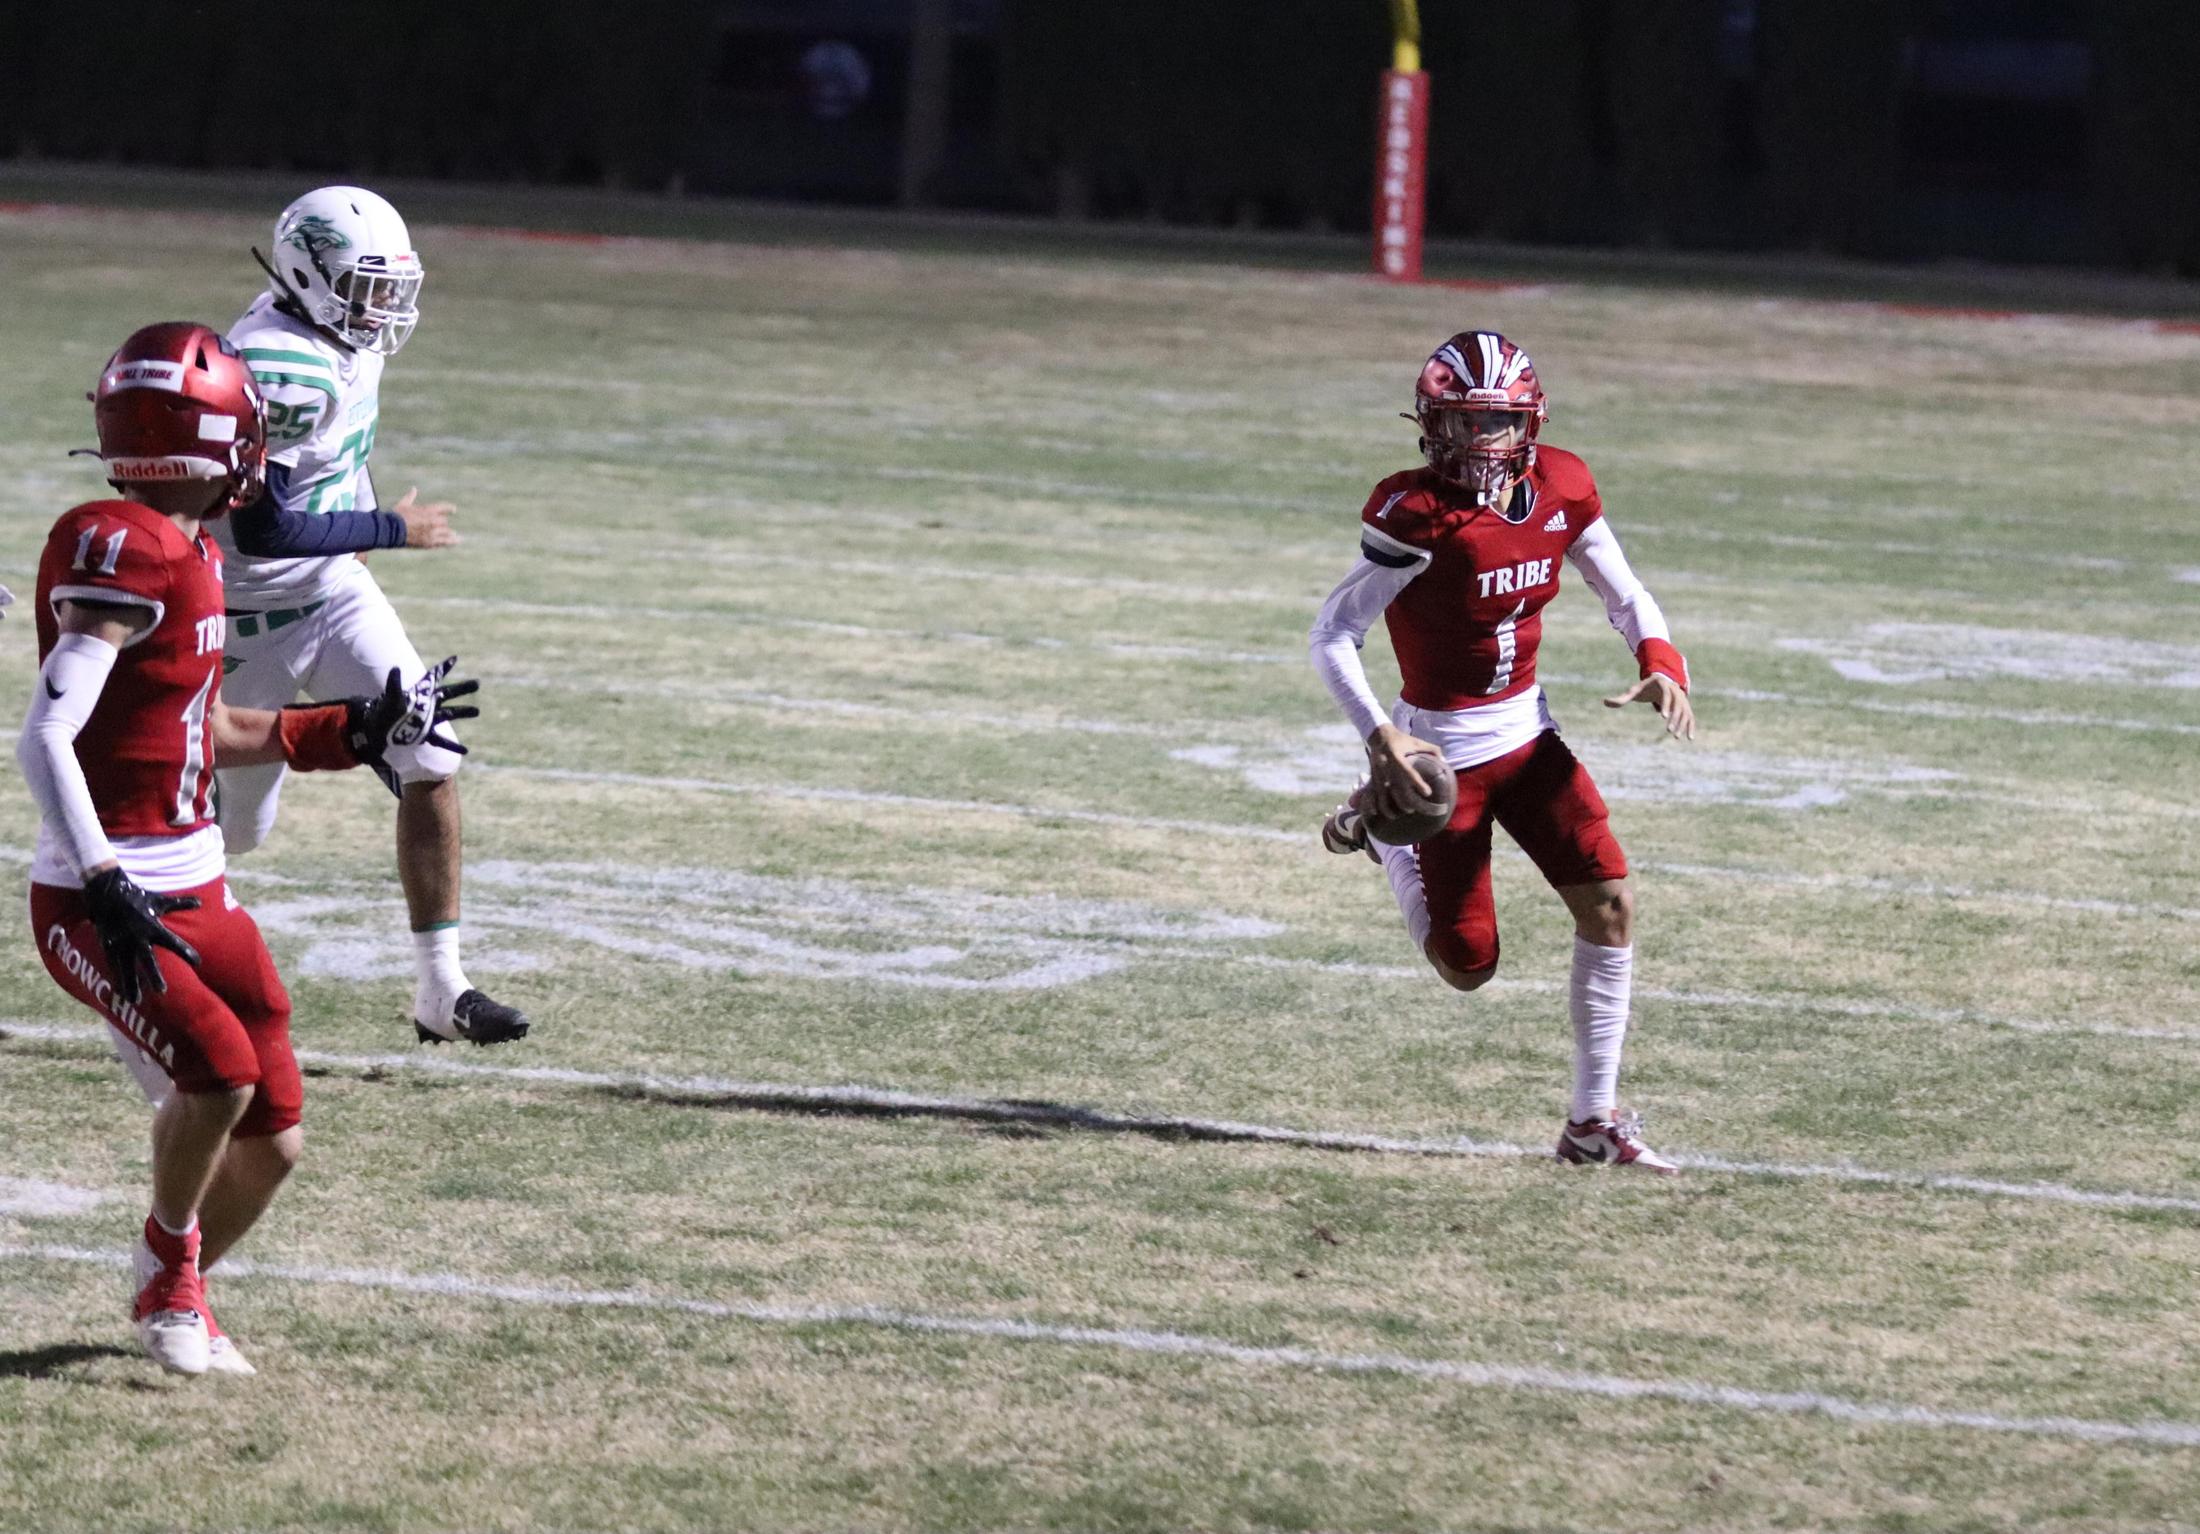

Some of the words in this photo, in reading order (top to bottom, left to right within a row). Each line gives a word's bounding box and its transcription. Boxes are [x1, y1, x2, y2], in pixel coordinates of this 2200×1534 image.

[141, 368, 174, 381] TRIBE
[266, 400, 320, 440] 25
[113, 461, 188, 479] Riddell
[1376, 490, 1408, 520] 1
[71, 524, 129, 576] 11
[1477, 558, 1552, 598] TRIBE
[195, 613, 226, 656] TRI
[1486, 597, 1526, 695] 1
